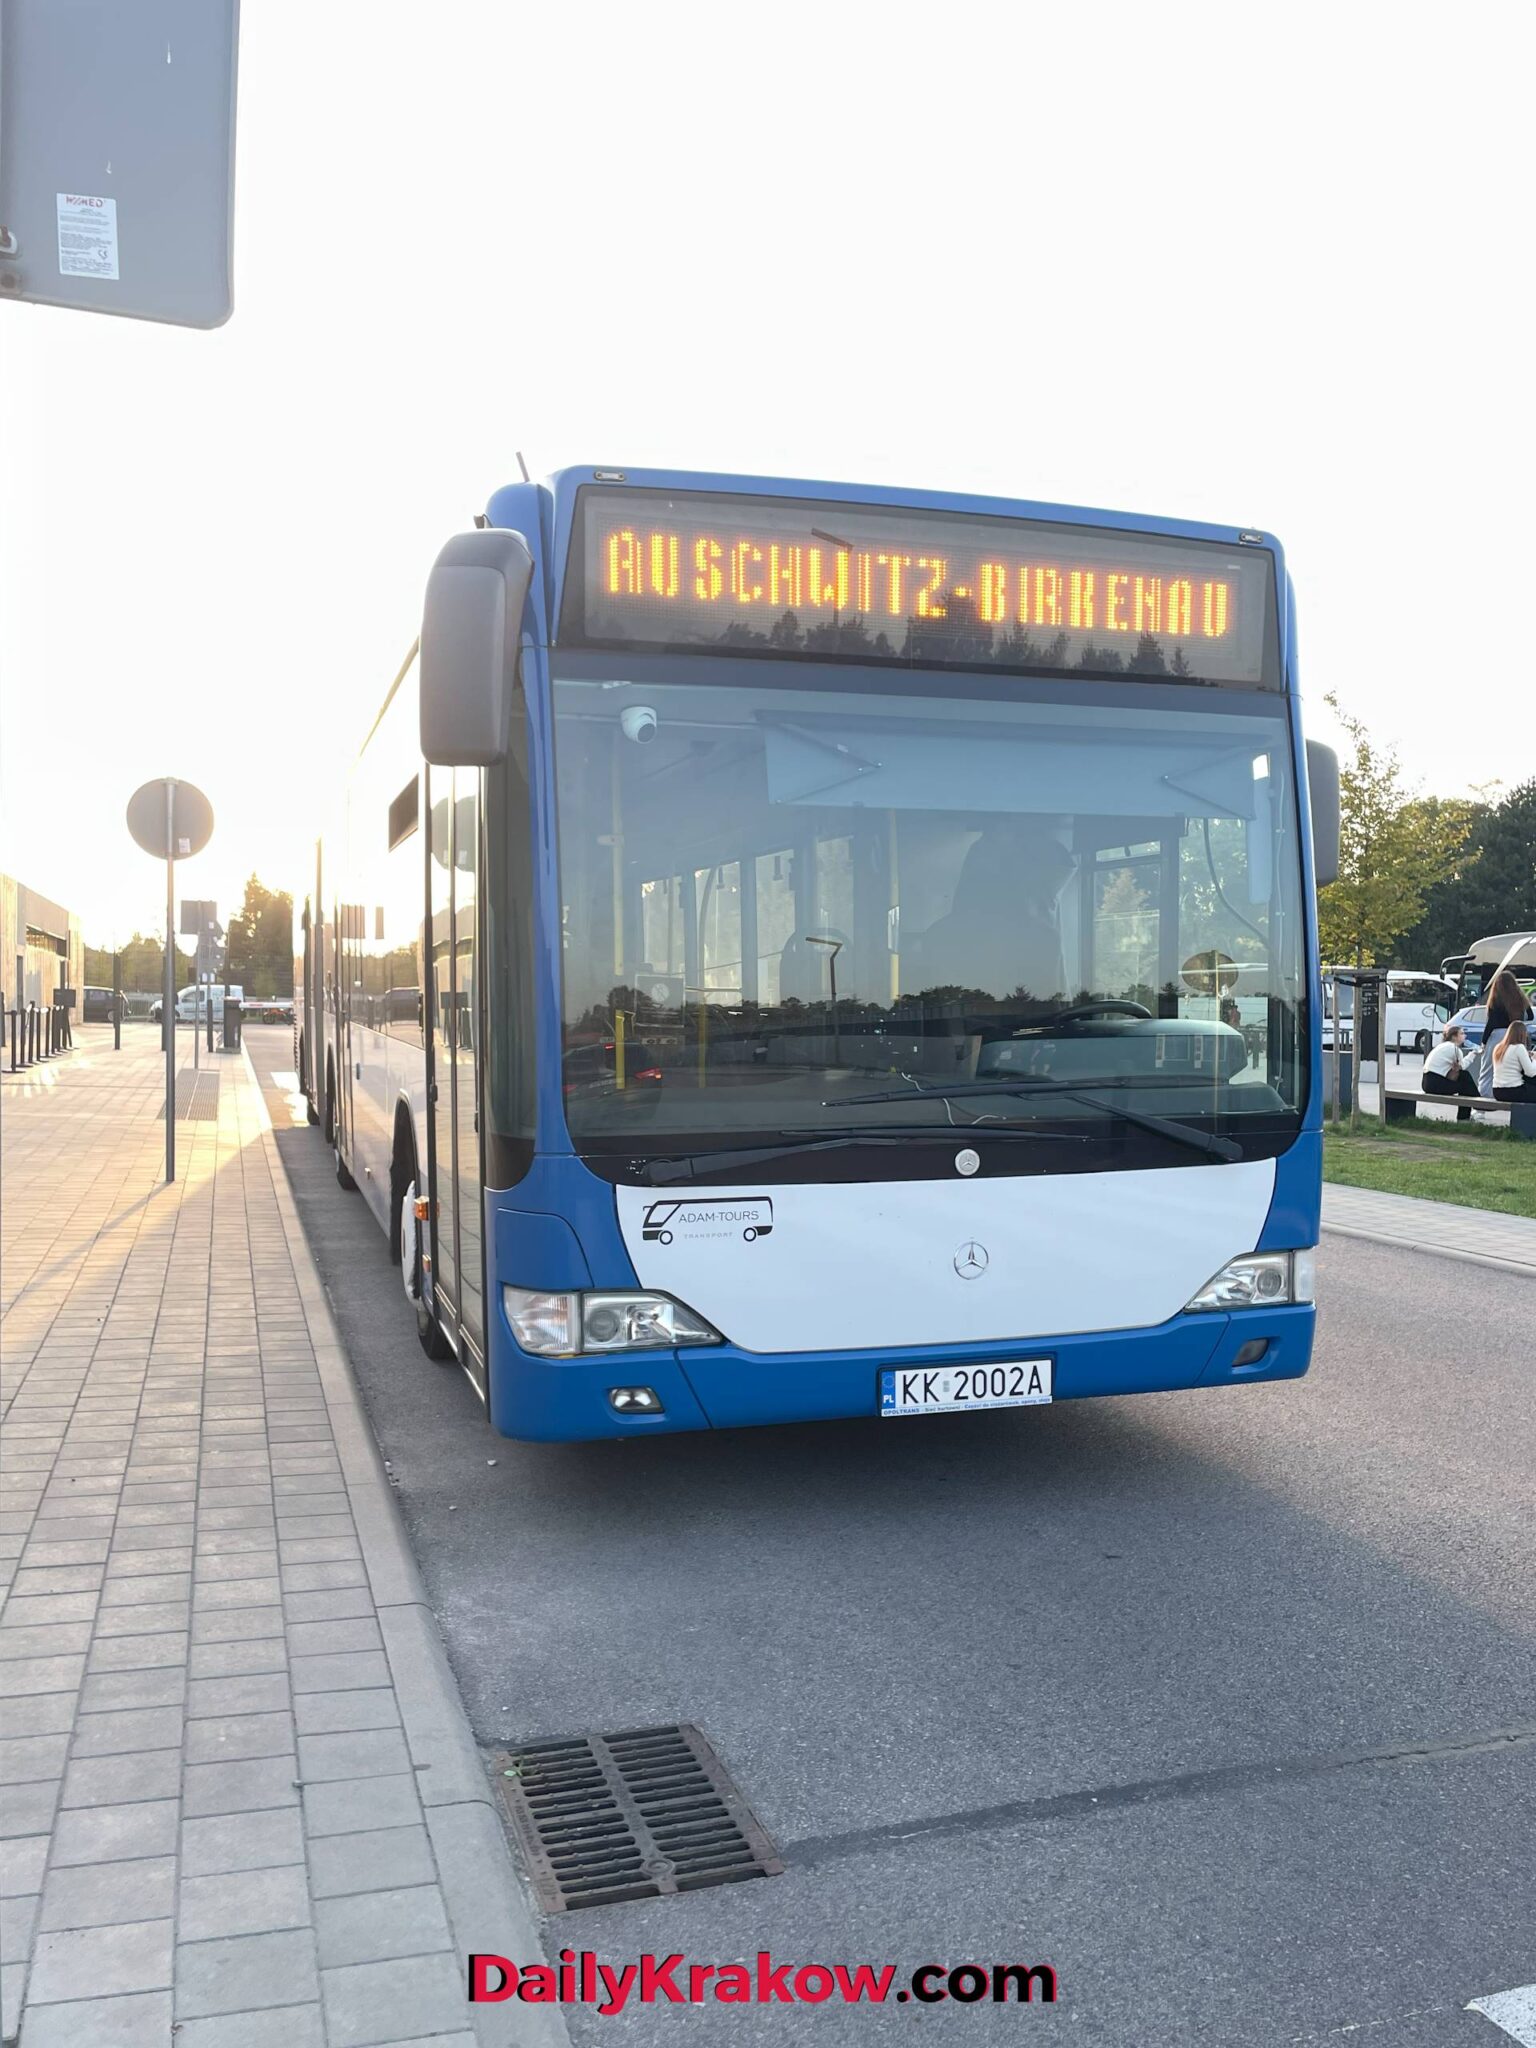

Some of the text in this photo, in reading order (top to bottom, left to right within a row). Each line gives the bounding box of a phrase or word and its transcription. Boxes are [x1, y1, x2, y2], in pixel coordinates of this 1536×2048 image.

[607, 530, 1228, 637] AUSCHWITZ-BIRKENAU
[678, 1210, 760, 1223] ADAM-TOURS
[684, 1231, 733, 1239] TRANSPORT
[883, 1364, 1043, 1405] PL KK 2002A
